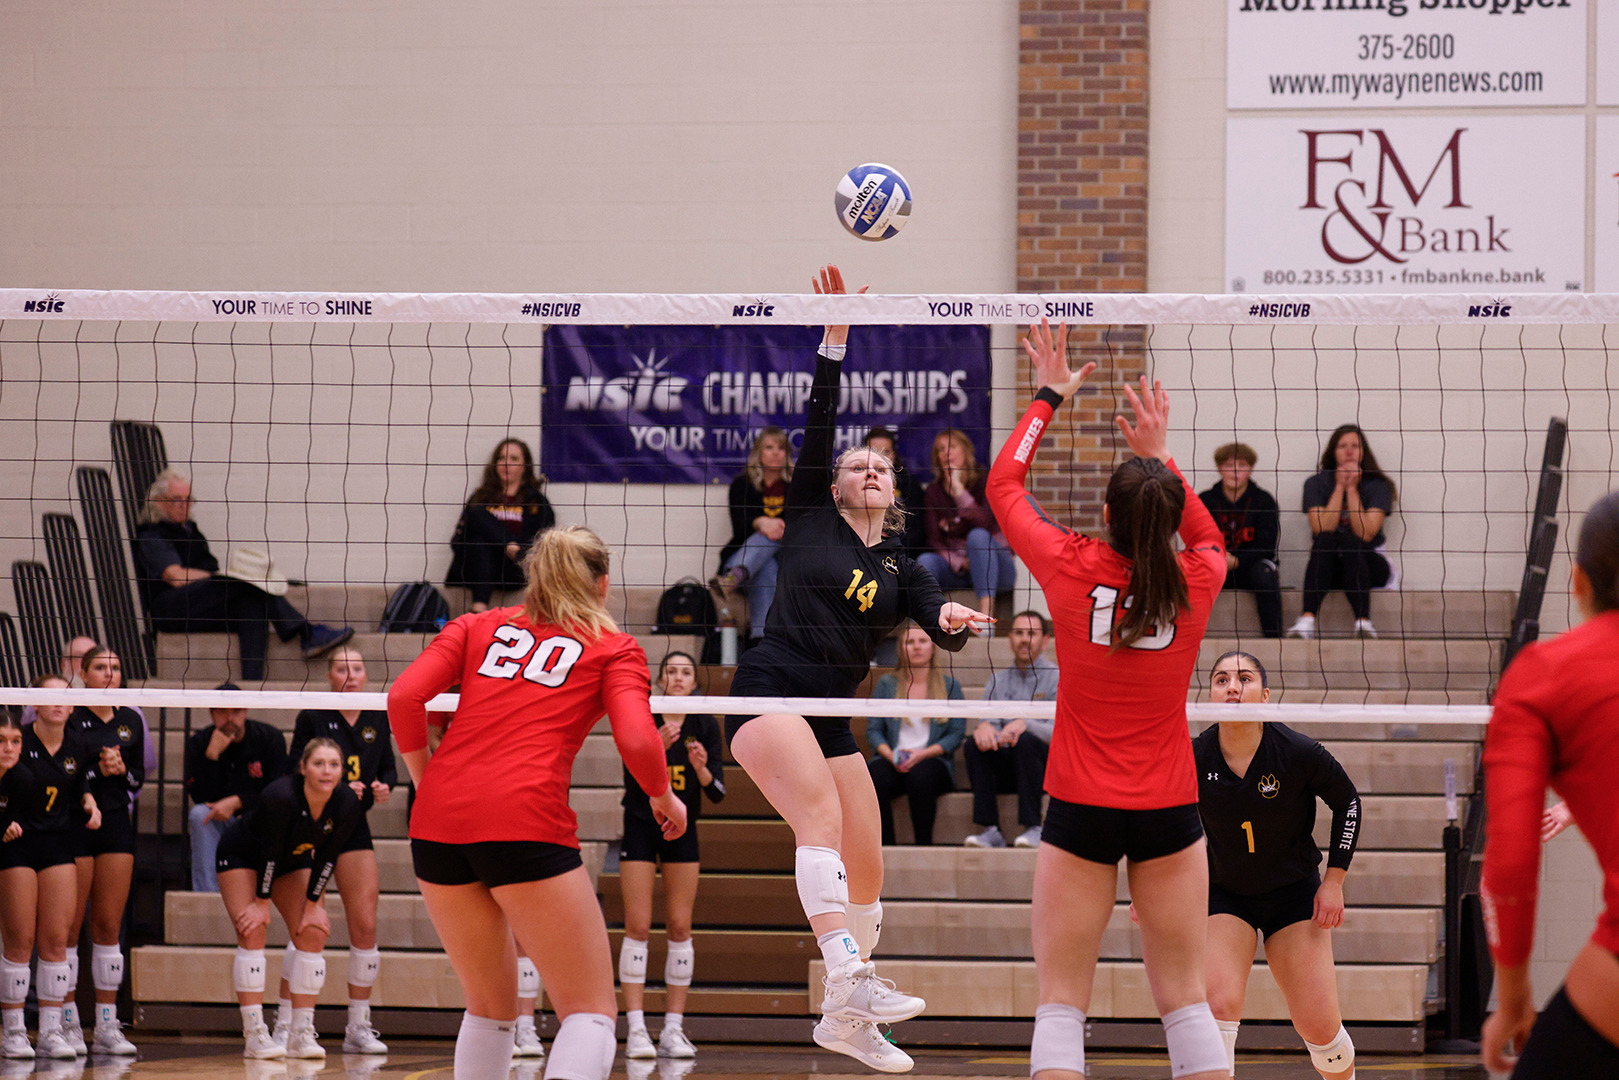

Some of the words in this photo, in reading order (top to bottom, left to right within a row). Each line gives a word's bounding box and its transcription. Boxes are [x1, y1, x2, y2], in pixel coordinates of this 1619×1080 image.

[1358, 34, 1455, 60] 375-2600
[1269, 71, 1544, 100] www.mywaynenews.com
[848, 180, 878, 219] molten
[860, 190, 888, 226] NCAA
[1397, 215, 1513, 253] Bank
[1262, 269, 1384, 285] 800.235.5331
[1401, 268, 1546, 284] fmbankne.bank
[212, 300, 257, 315] YOUR
[261, 301, 294, 316] TIME
[299, 302, 321, 316] TO
[325, 301, 373, 316] SHINE
[521, 302, 581, 317] #NSICVB
[928, 302, 974, 318] YOUR
[979, 303, 1013, 317] TIME
[1018, 303, 1040, 317] TO
[1045, 302, 1094, 318] SHINE
[1248, 303, 1311, 318] #NSICVB
[703, 369, 969, 416] CHAMPONSHIPS
[628, 426, 706, 451] YOUR
[712, 427, 764, 451] TIM
[1013, 416, 1044, 464] HUSKIES
[843, 568, 879, 613] 14
[477, 624, 584, 688] 20
[347, 755, 360, 781] 3
[45, 785, 59, 812] 7
[1240, 821, 1255, 854] 1
[1339, 820, 1357, 850] STATE
